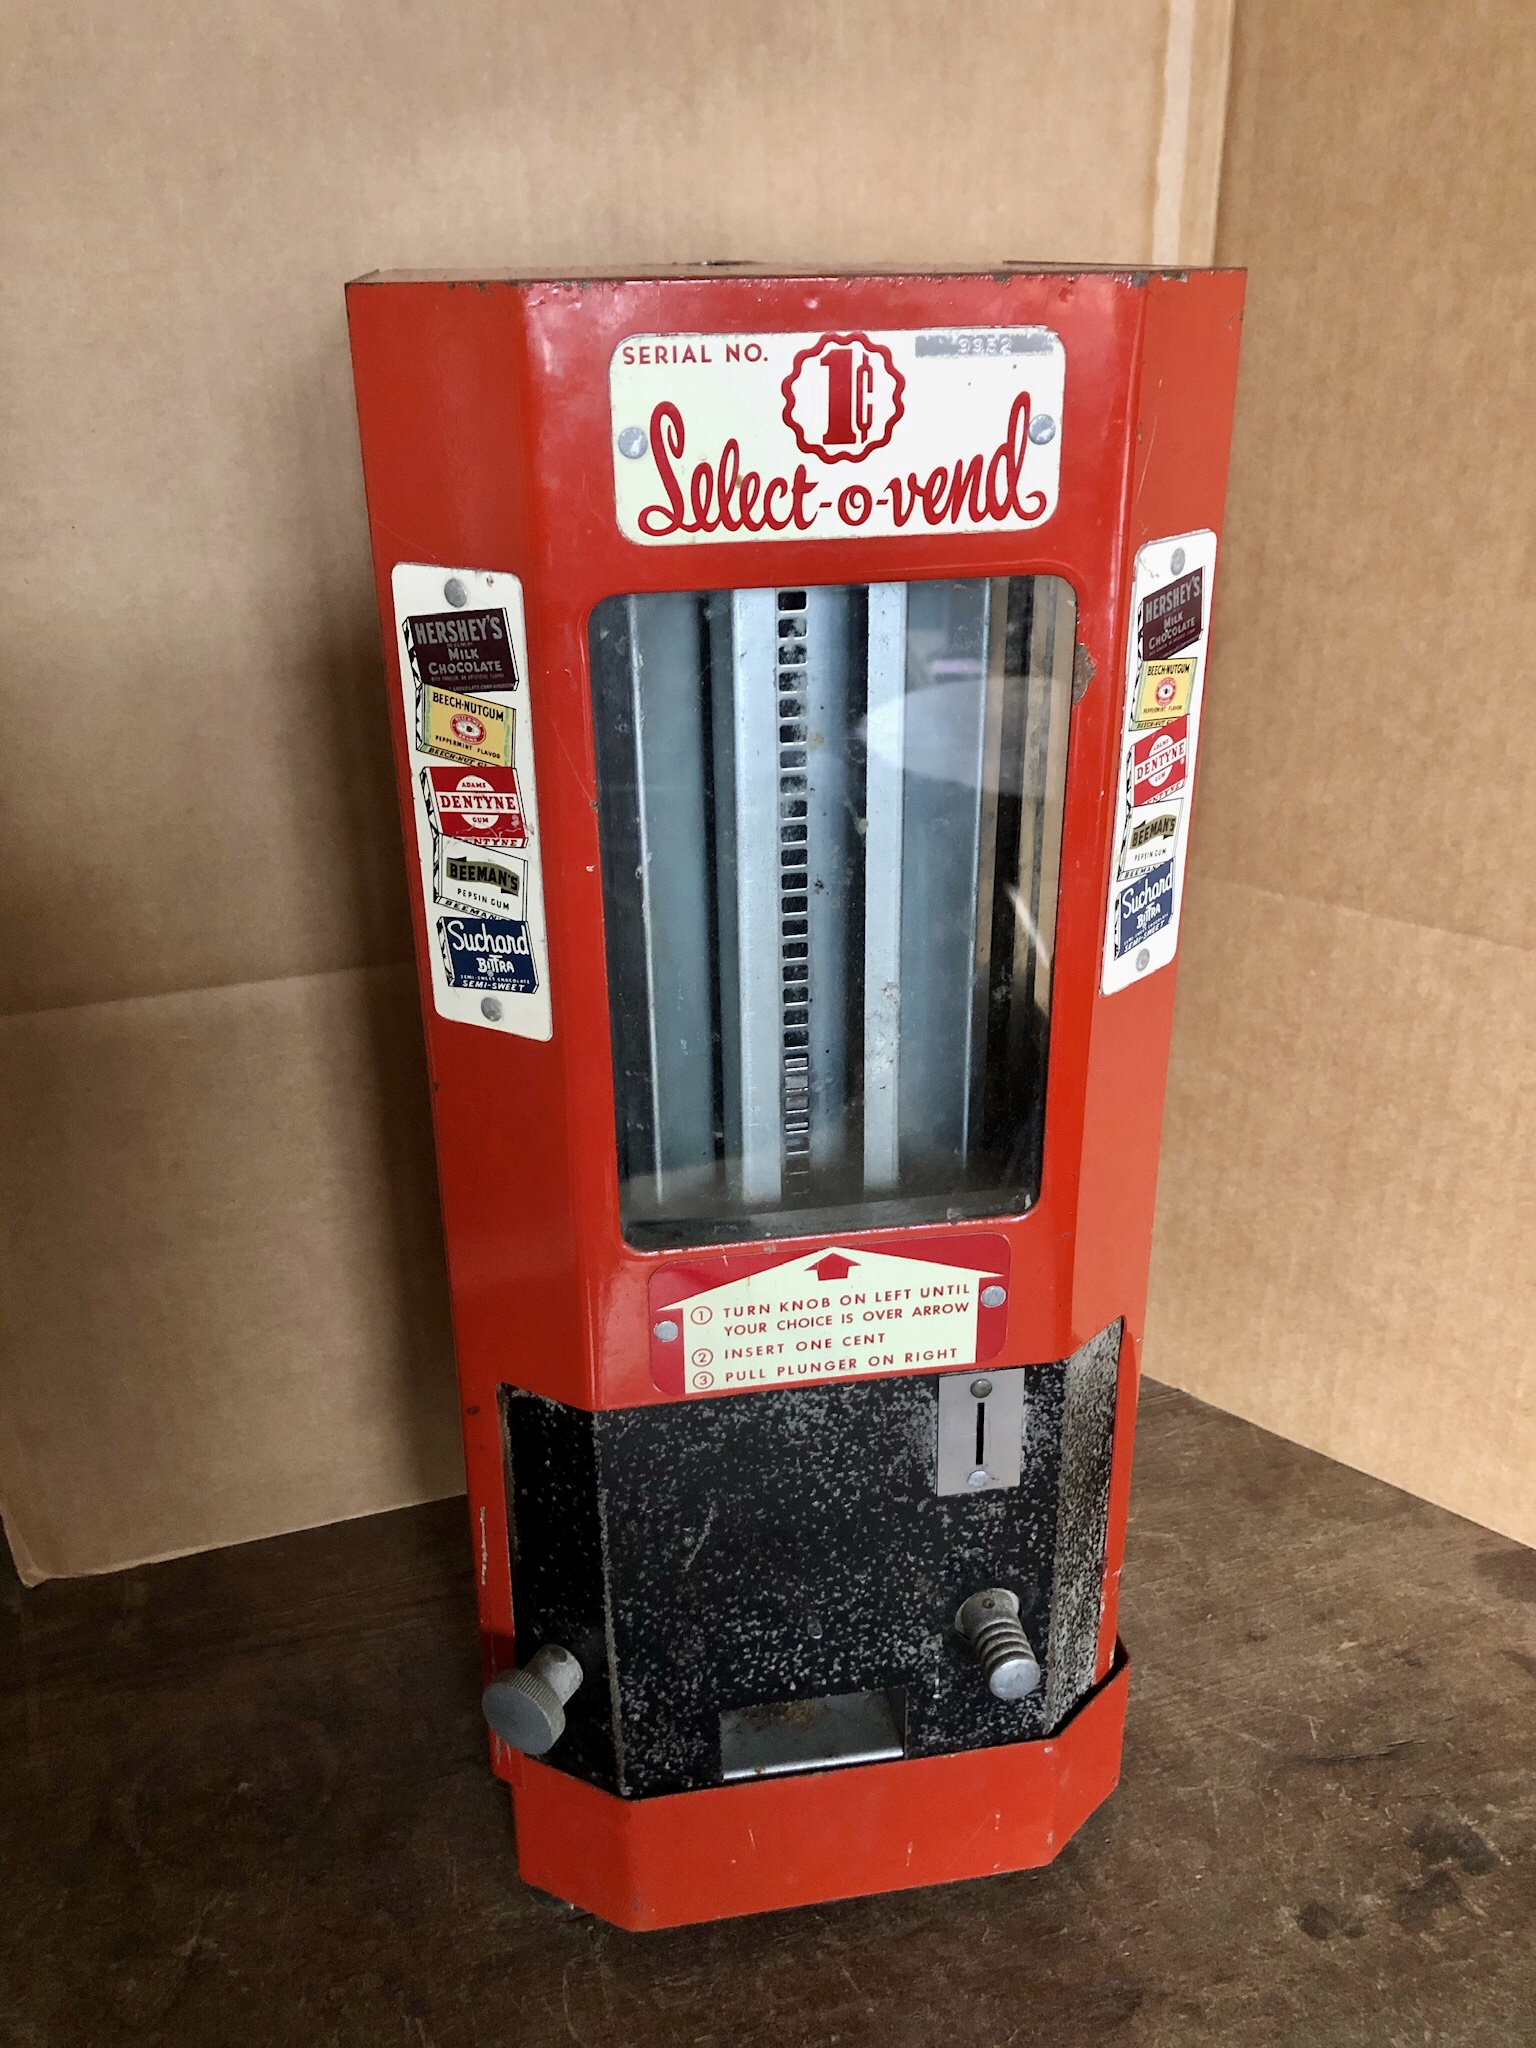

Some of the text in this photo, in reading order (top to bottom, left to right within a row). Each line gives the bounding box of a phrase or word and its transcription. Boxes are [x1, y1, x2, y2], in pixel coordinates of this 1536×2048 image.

[622, 343, 768, 364] SERIAL NO.
[1145, 575, 1201, 624] HERSHEY'S
[414, 614, 504, 645] HERSHEY'S
[1149, 617, 1196, 650] CHOCOLATE
[1163, 611, 1184, 630] MILK
[428, 660, 503, 676] CHOCOLATE
[447, 648, 479, 661] MILK
[435, 735, 501, 760] PEPPERMINT FLAVOR
[1137, 741, 1185, 781] DENTYNE
[439, 795, 517, 811] DENTYNE
[472, 816, 489, 824] GUM
[1132, 818, 1176, 847] BEEMAN'S
[473, 838, 519, 847] NTYNE
[450, 862, 519, 891] BEEMAN'S
[457, 888, 510, 911] PEPSIN GUM
[1122, 866, 1172, 919] Suchard
[447, 920, 530, 956] Suchard
[462, 979, 526, 992] SEMI-SWEET
[723, 1303, 770, 1318] TURN
[779, 1297, 830, 1312] KNOB
[839, 1293, 866, 1307] ON
[874, 1288, 912, 1303] LEFT
[919, 1283, 970, 1299] UNTIL
[723, 1301, 970, 1337] YOUR CHOICE IS OVER ARROW
[723, 1344, 784, 1360] INSERT
[795, 1337, 832, 1352] ONE
[842, 1332, 885, 1347] CENT
[725, 1368, 766, 1383] PULL
[776, 1358, 858, 1377] PLUNGER
[867, 1353, 894, 1369] ON
[904, 1347, 958, 1364] RIGHT
